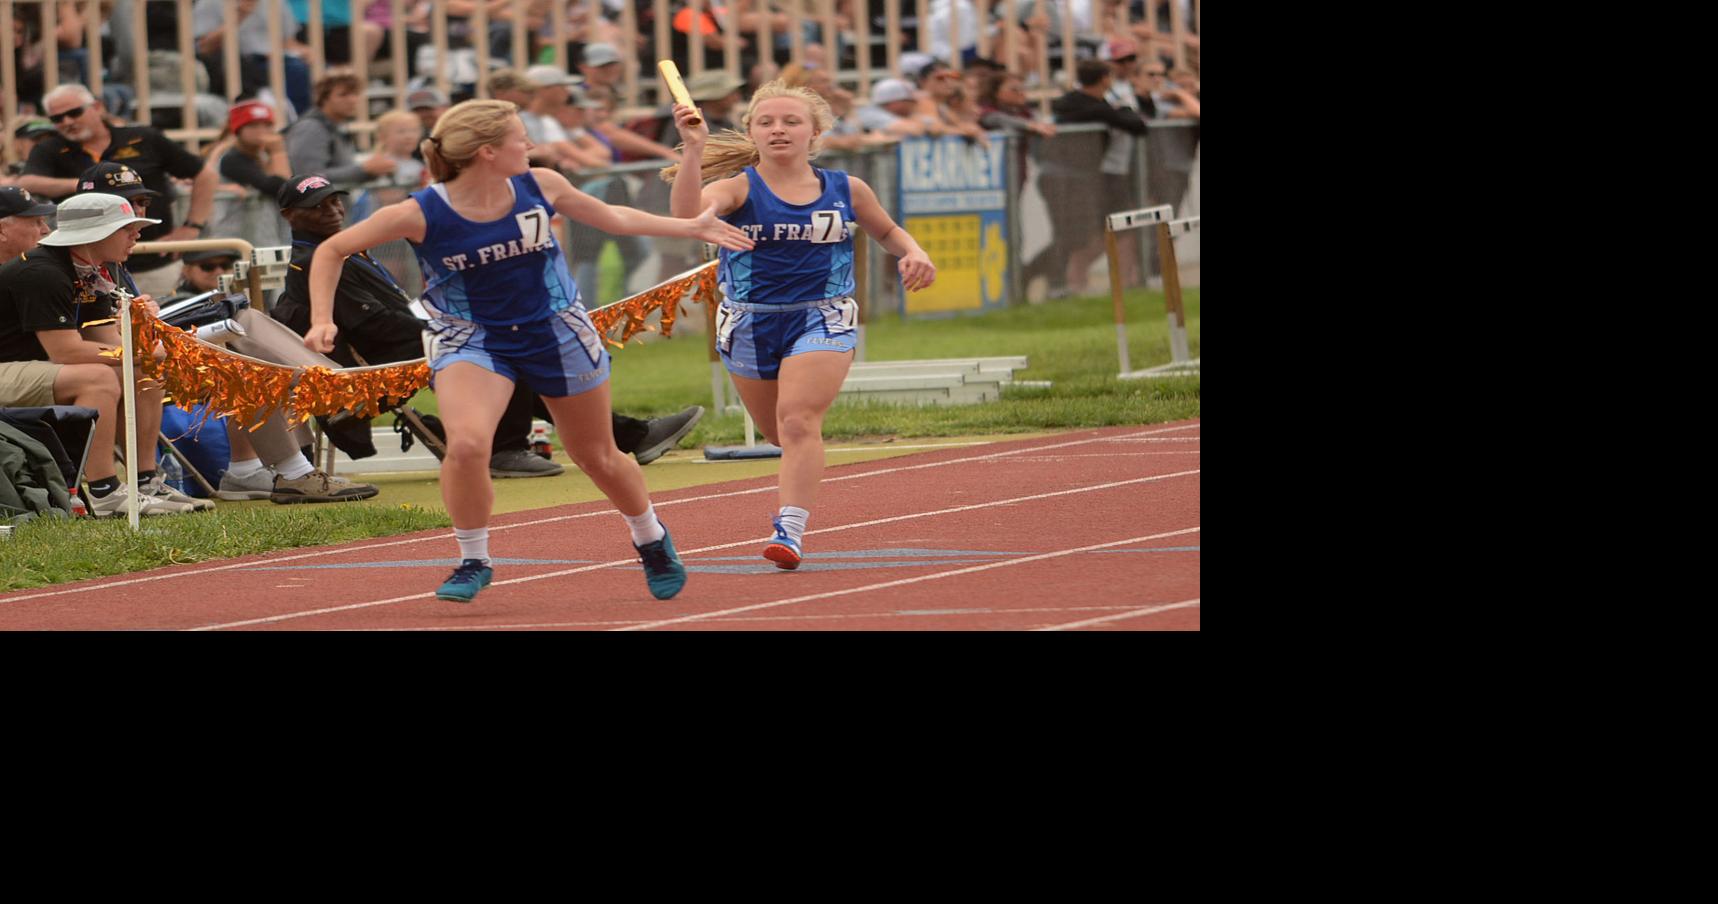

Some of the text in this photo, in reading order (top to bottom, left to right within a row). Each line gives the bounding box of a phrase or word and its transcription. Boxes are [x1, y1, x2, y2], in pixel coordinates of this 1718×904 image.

[524, 212, 541, 243] 7
[818, 212, 834, 241] 7
[442, 253, 475, 272] ST.
